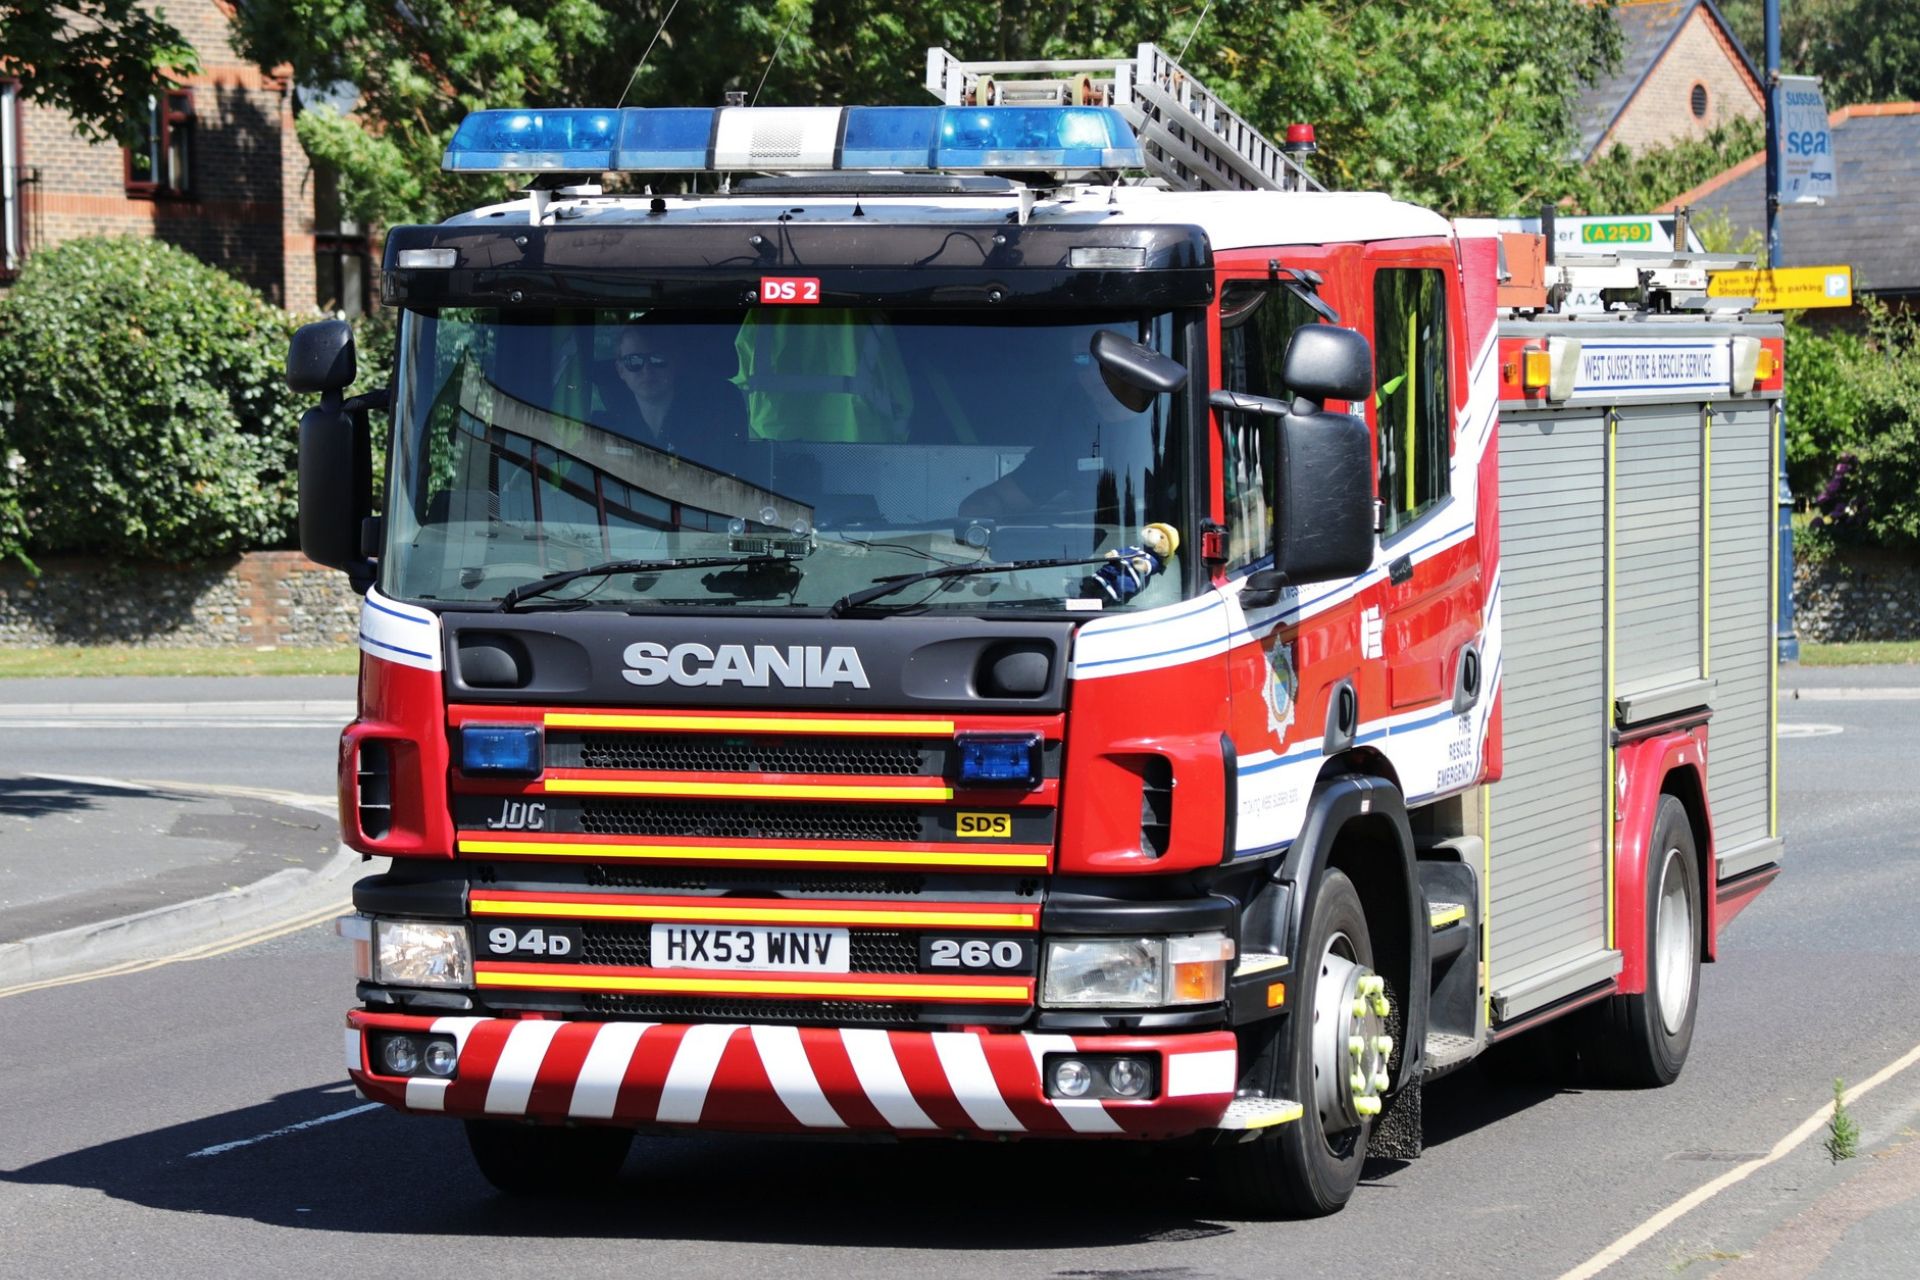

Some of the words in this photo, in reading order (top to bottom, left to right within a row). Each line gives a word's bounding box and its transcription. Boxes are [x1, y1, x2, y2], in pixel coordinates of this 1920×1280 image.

[1785, 91, 1823, 106] sussex
[1787, 131, 1826, 155] sea
[764, 281, 797, 300] DS
[803, 281, 818, 300] 2
[1787, 283, 1823, 293] parking
[1584, 355, 1605, 381] WEST
[1607, 354, 1633, 380] SUSSEX
[1635, 353, 1650, 380] FIRE
[1652, 354, 1656, 377] &
[1658, 353, 1684, 378] RESCUE
[1686, 353, 1711, 377] SERVICE
[622, 642, 870, 688] SCANIA
[1459, 715, 1471, 736] FIRE
[1449, 738, 1471, 760] RESCUE
[1437, 761, 1472, 788] EMERGENCY
[960, 816, 1007, 833] SDS
[489, 927, 571, 955] 94D
[667, 929, 755, 962] HX53
[766, 932, 833, 965] WNV
[930, 939, 1023, 968] 260
